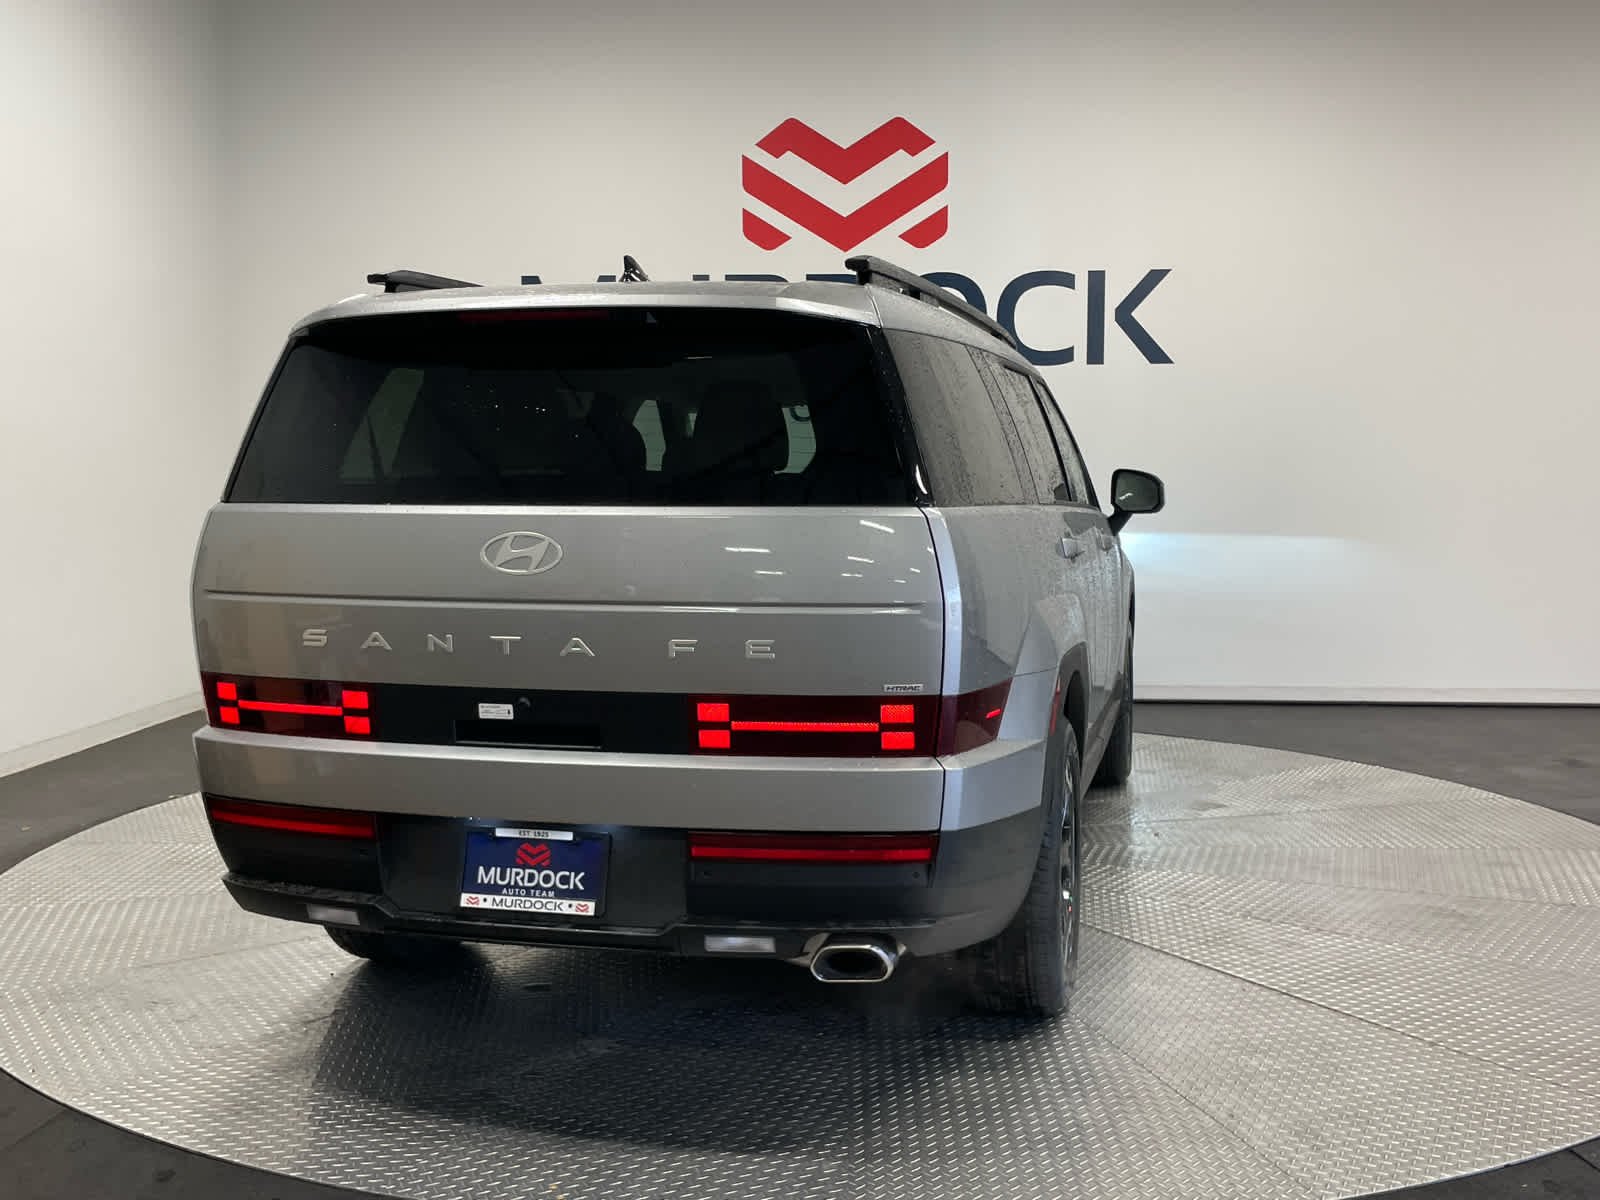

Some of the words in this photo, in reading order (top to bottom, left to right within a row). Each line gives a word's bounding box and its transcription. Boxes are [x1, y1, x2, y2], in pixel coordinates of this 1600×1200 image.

[302, 629, 596, 658] SANTA
[668, 639, 776, 660] FE
[477, 866, 584, 890] MURDOCK
[502, 888, 526, 896] AUTO
[530, 889, 555, 897] TEAM
[491, 897, 563, 911] MURDOCK
